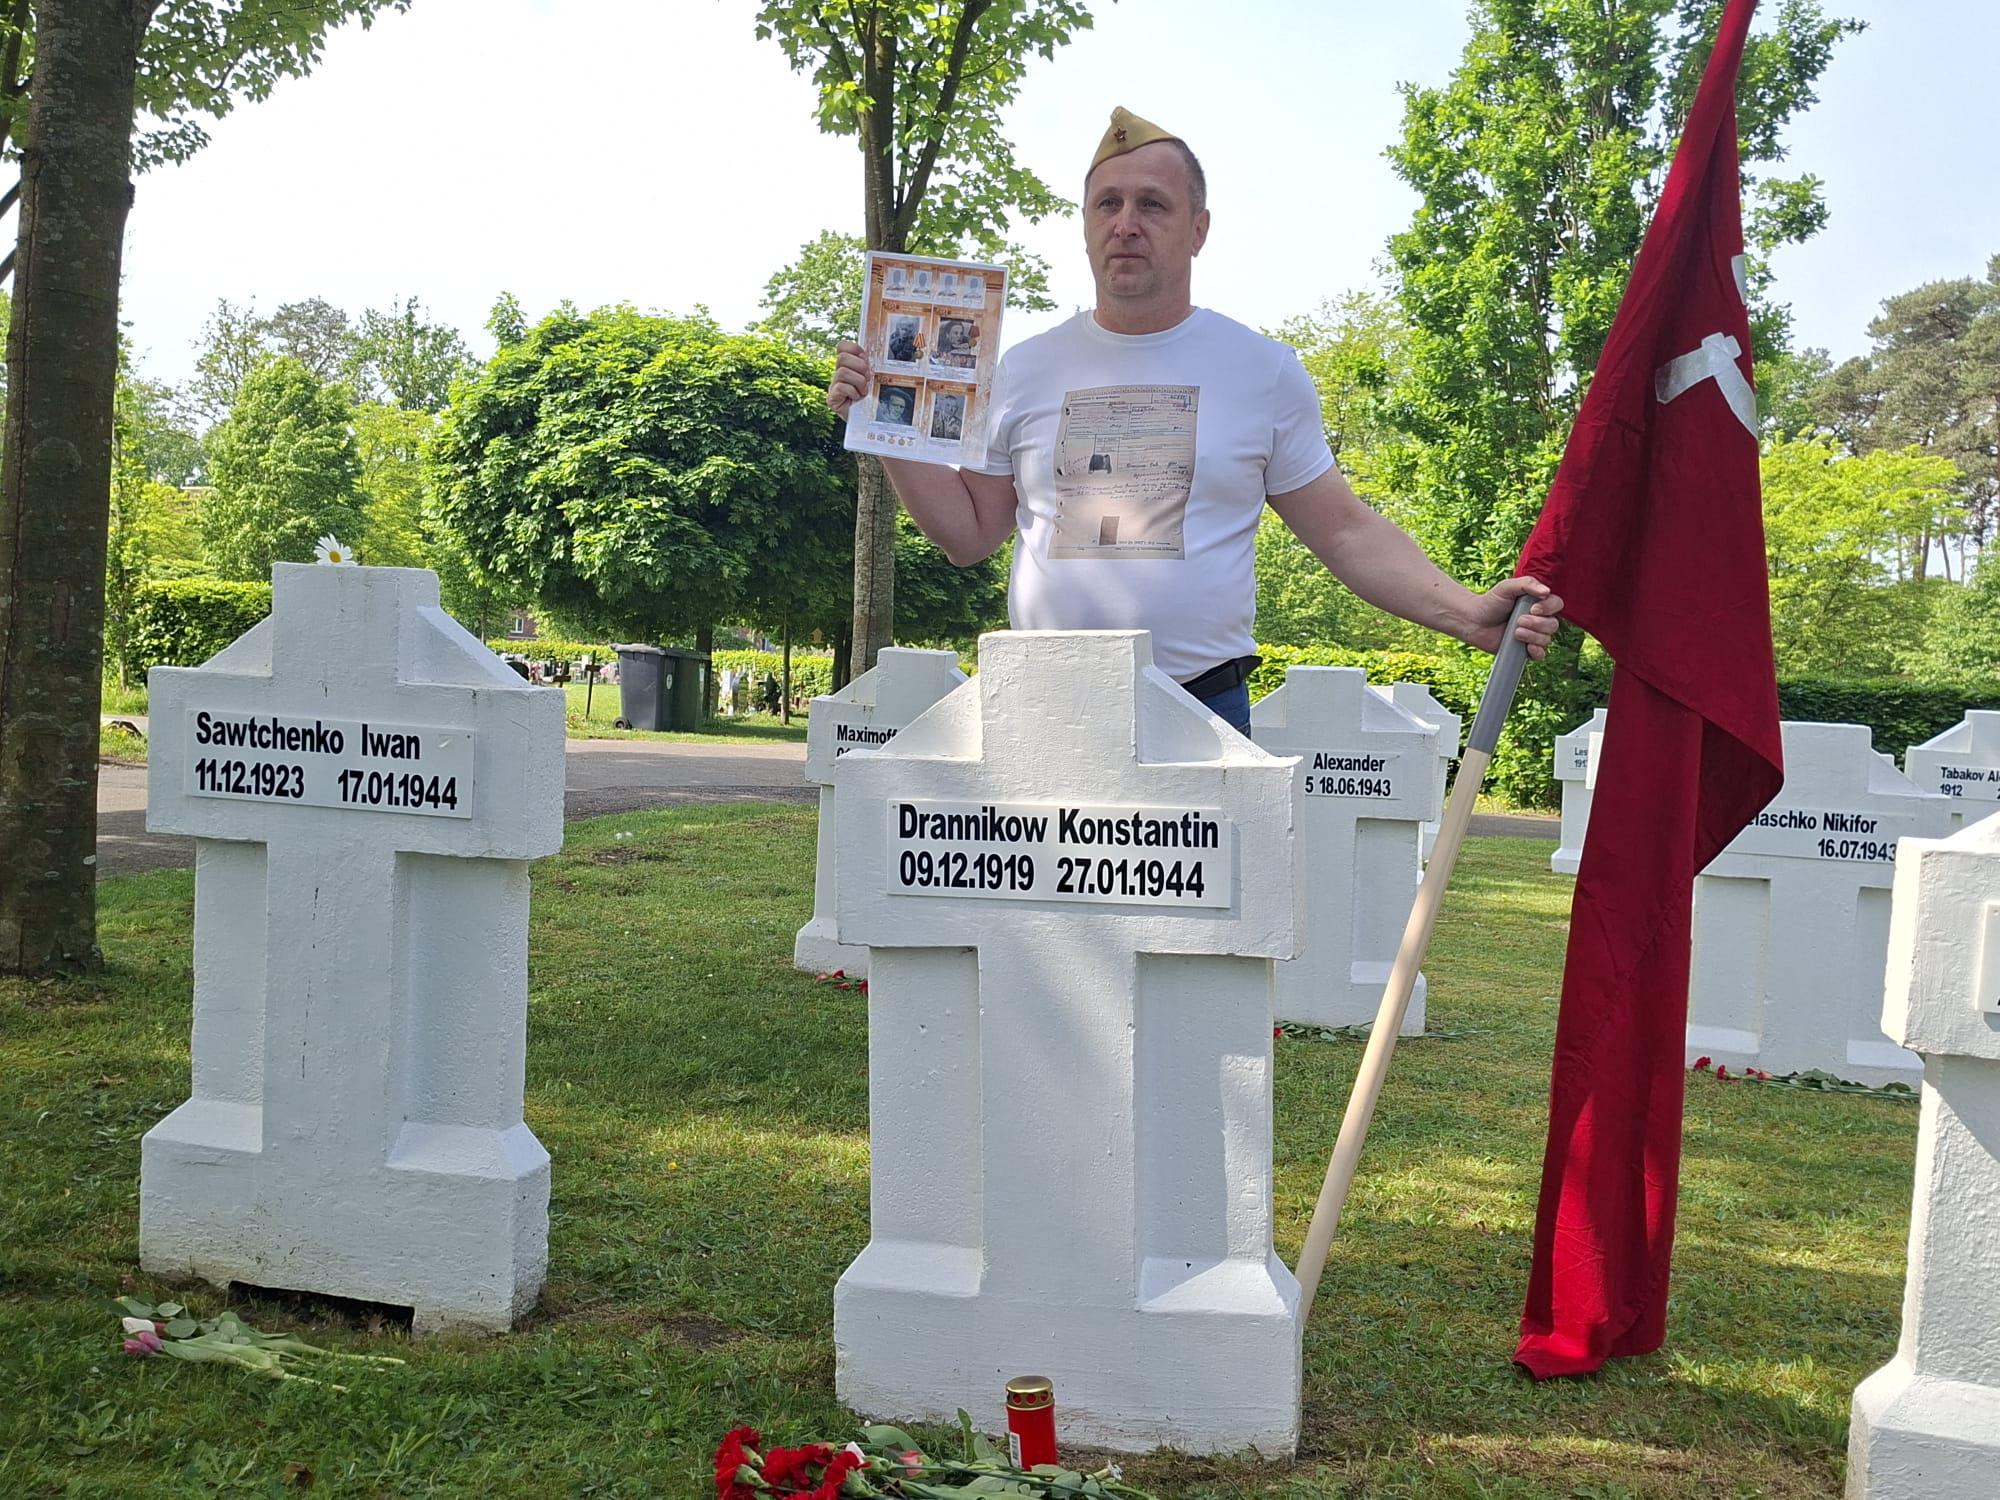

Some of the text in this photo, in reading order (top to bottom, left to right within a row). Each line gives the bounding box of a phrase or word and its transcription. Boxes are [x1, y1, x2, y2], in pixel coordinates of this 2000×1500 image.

[195, 711, 421, 760] Sawtchenko Iwan
[1312, 752, 1386, 773] Alexander
[1940, 766, 2000, 782] Tabakov Al
[195, 758, 458, 810] 11.12.1923 17.01.1944
[1319, 776, 1392, 797] 18.06.1943
[1940, 783, 1963, 797] 1912
[899, 803, 1220, 849] Drannikow Konstantin
[1822, 812, 1878, 834] Nikifor
[1817, 837, 1897, 862] 16.07.1943
[899, 850, 1205, 898] 09.12.1919 27.01.1944
